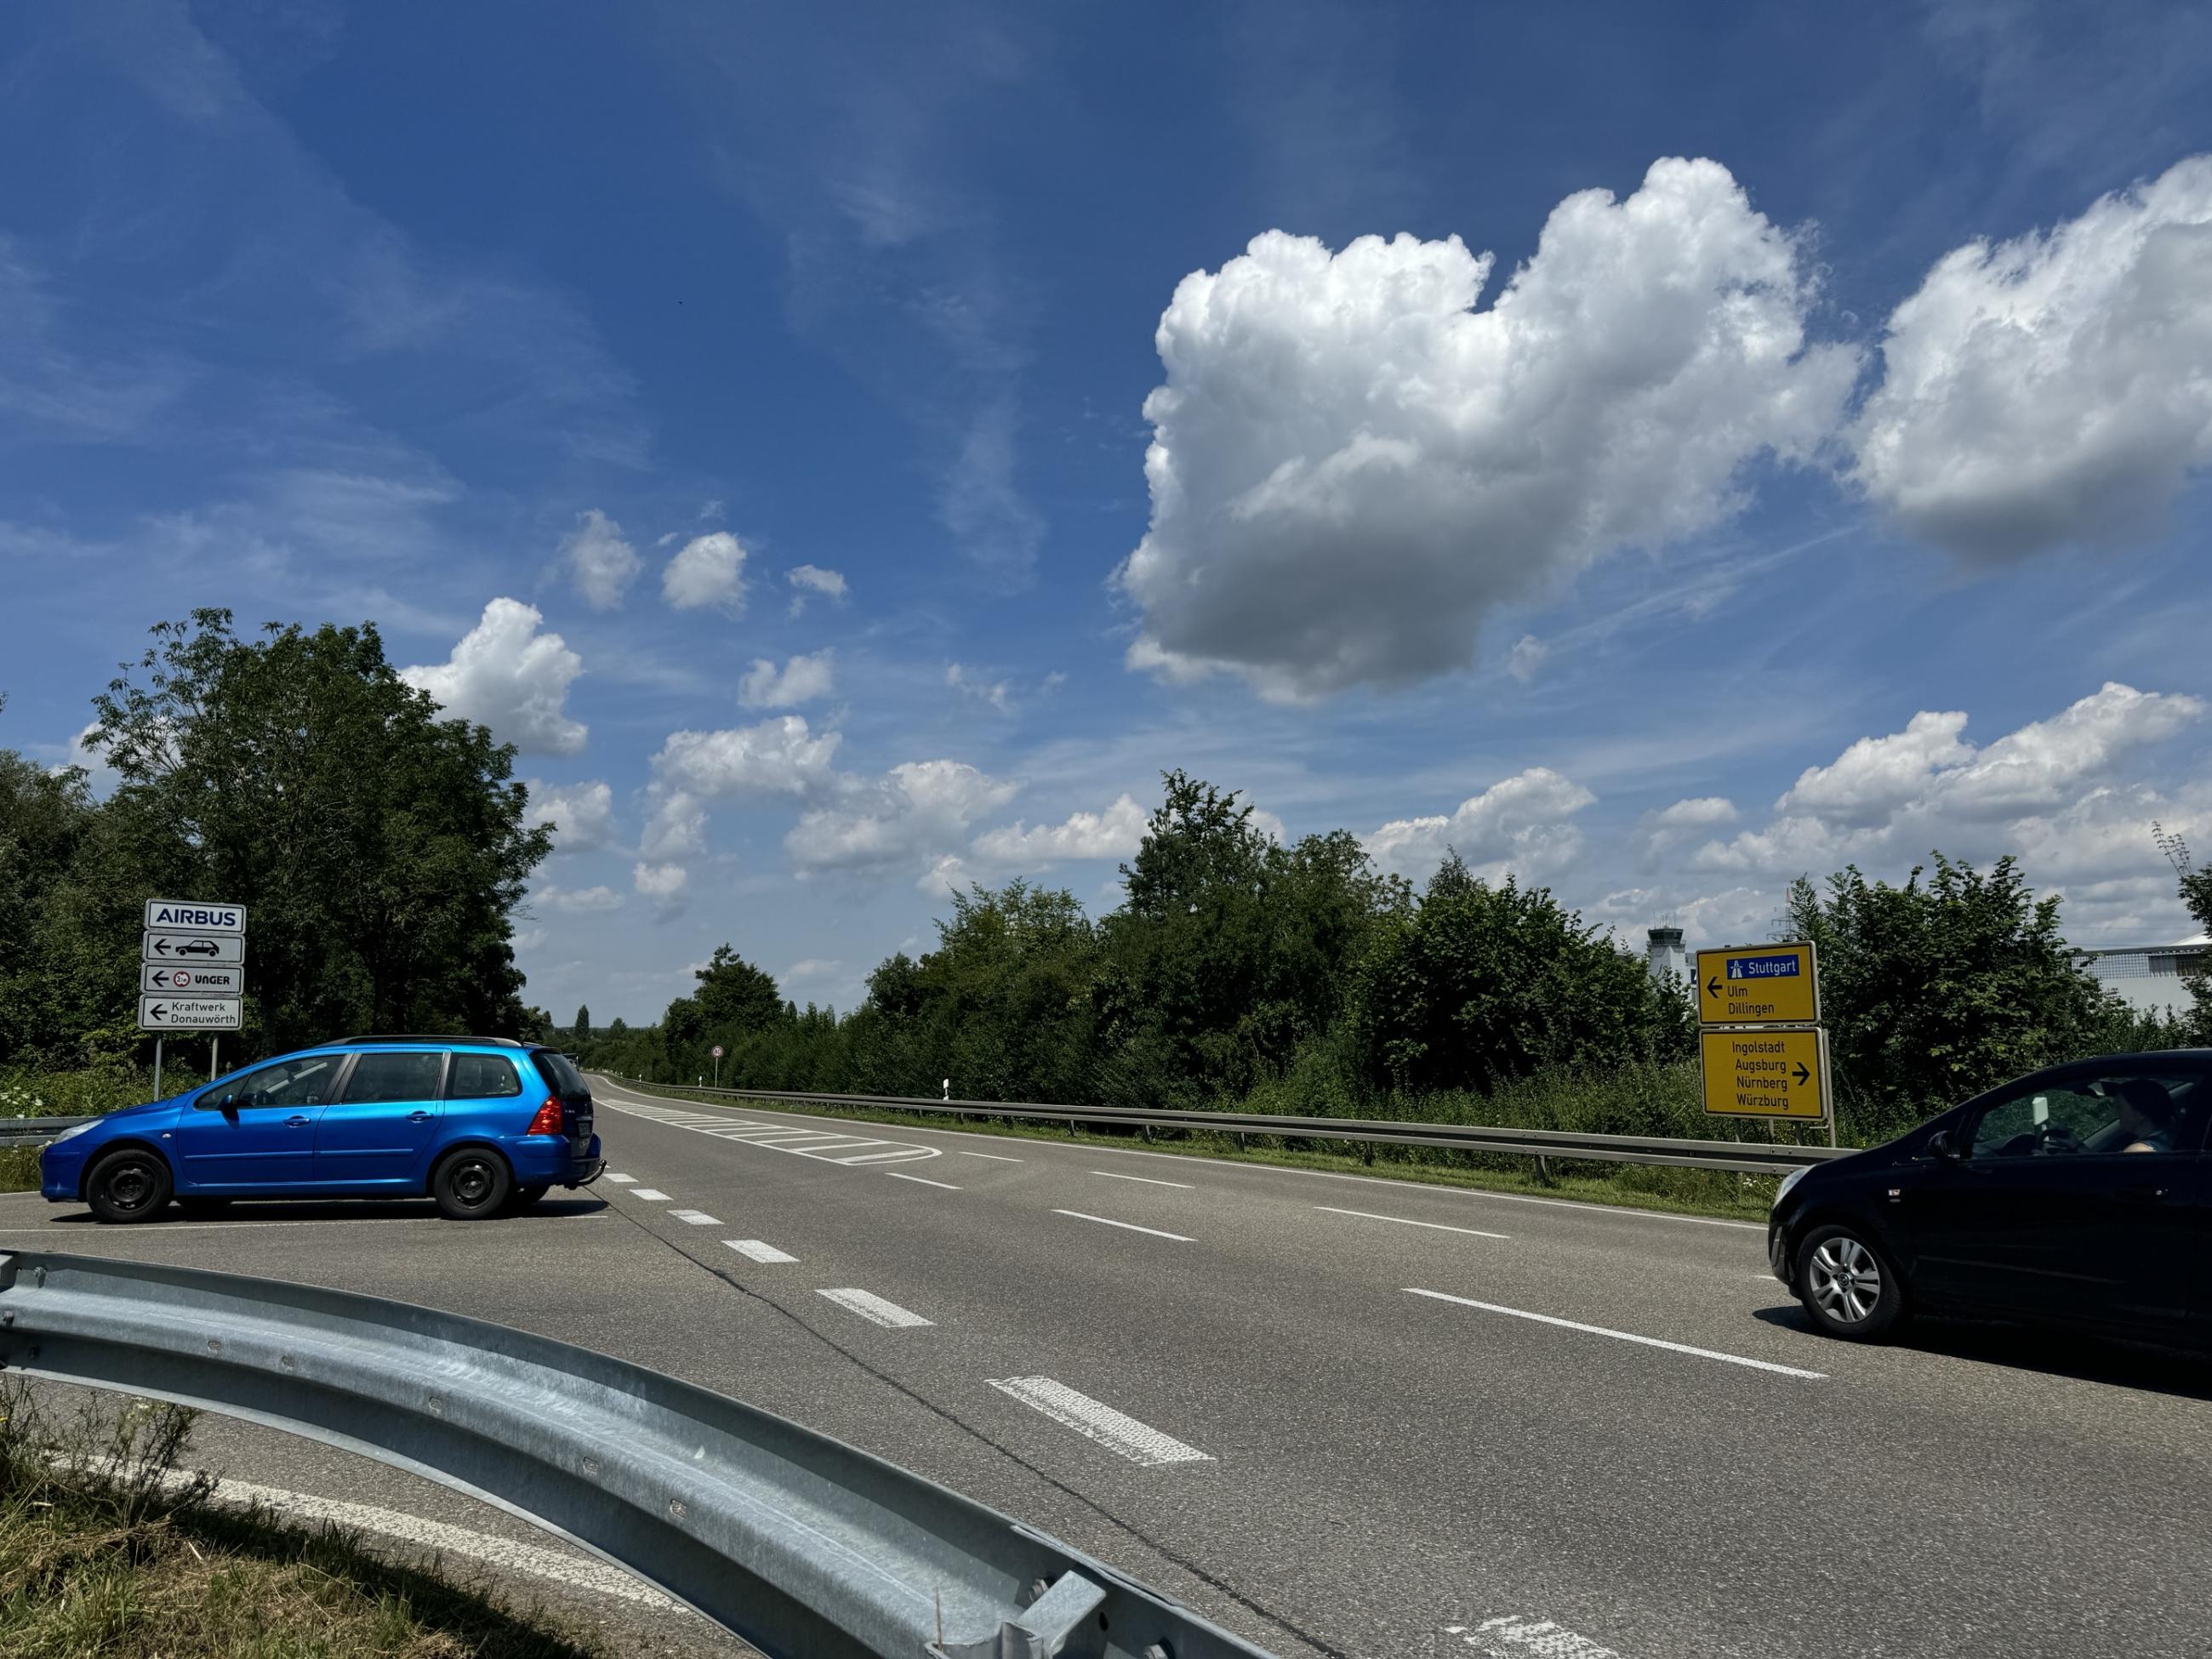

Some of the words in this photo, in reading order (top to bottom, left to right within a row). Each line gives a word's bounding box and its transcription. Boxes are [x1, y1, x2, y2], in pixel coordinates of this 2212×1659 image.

[156, 908, 236, 926] AIRBUS
[1748, 959, 1796, 977] Stuttgart
[1727, 985, 1748, 998] Ulm
[172, 1001, 225, 1012] Kraftwerk
[1728, 1002, 1775, 1017] Dillingen
[171, 1014, 236, 1023] Donauwörth
[1732, 1040, 1786, 1056] Ingolstadt
[1735, 1058, 1787, 1074] Augsburg
[1736, 1075, 1787, 1091] Nürnberg
[1736, 1093, 1789, 1109] Würzburg
